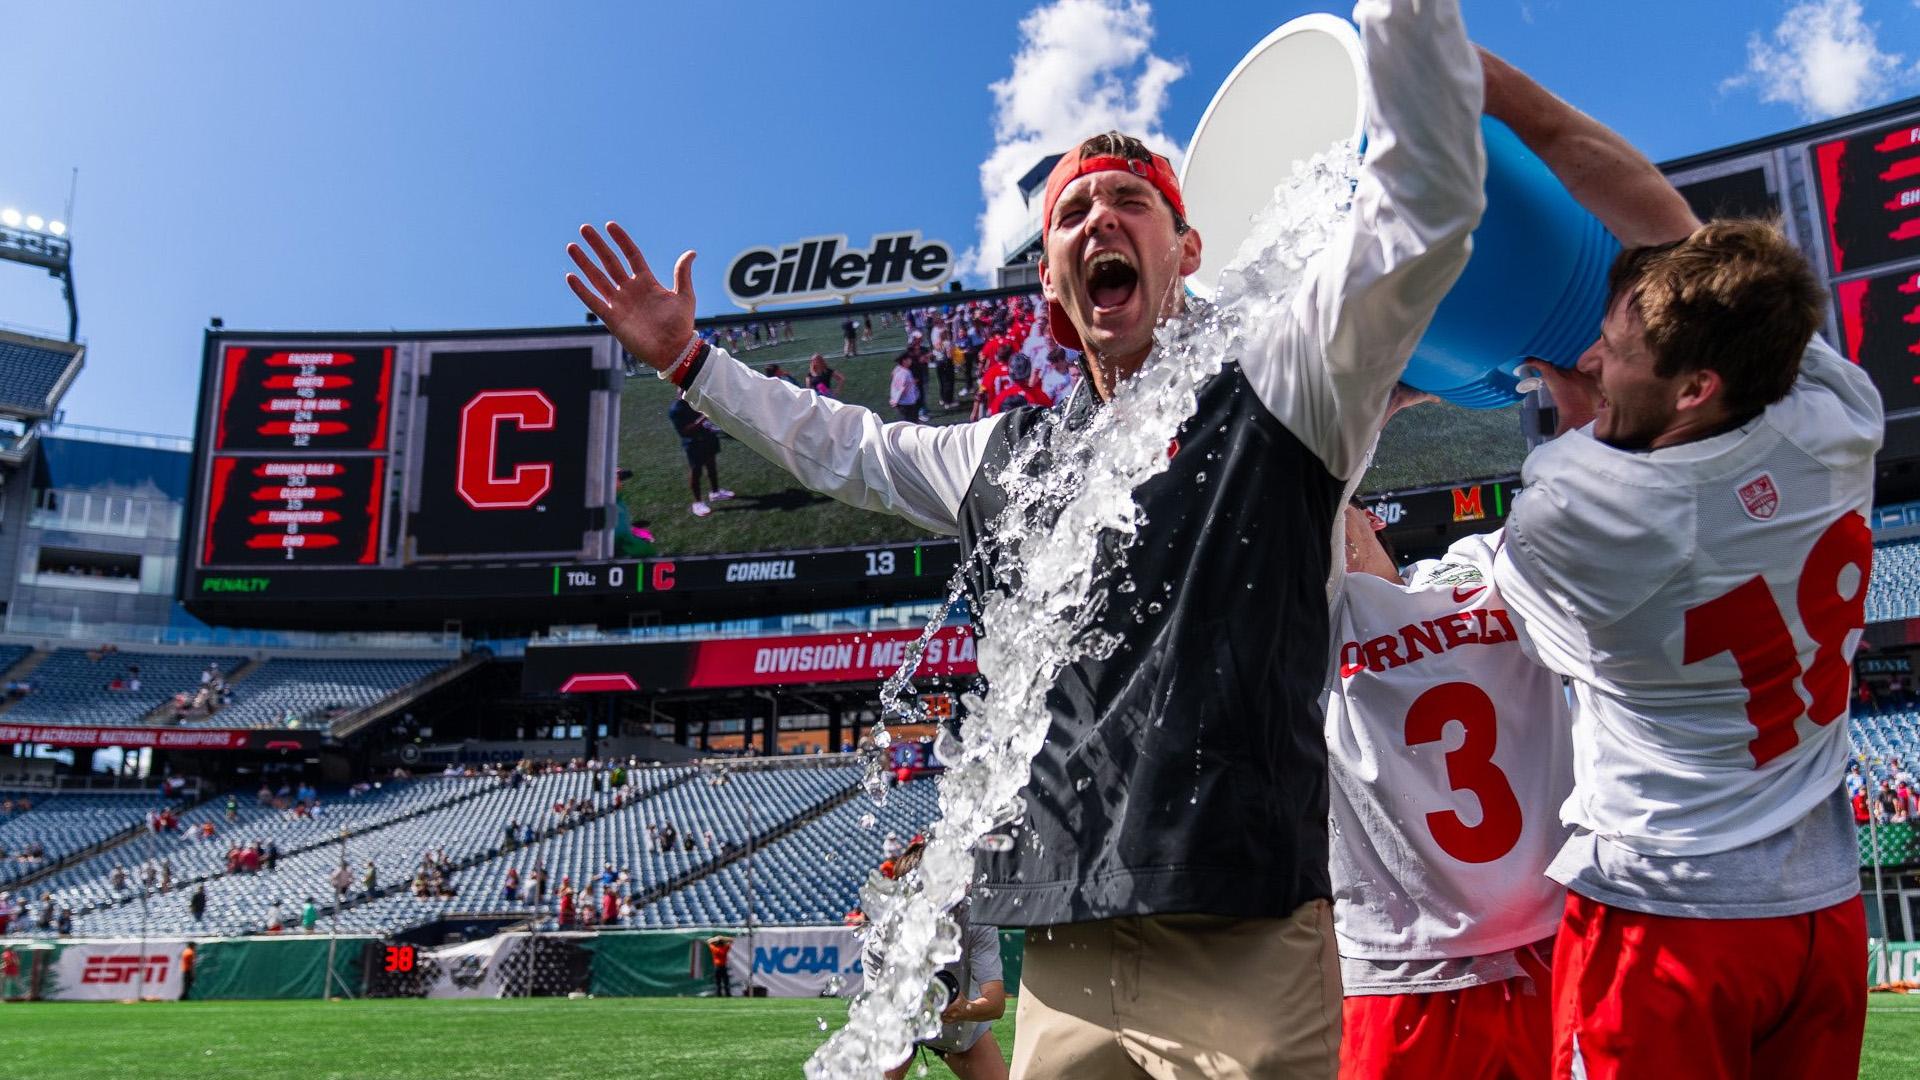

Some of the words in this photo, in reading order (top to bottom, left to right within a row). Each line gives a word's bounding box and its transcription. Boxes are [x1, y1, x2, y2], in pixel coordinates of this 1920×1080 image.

[729, 236, 948, 298] Gillette
[293, 376, 325, 387] SHOTS
[271, 398, 302, 410] SHOTS
[303, 398, 317, 410] ON
[318, 398, 341, 410] GOAL
[289, 422, 320, 434] SAVES
[457, 388, 556, 509] C
[265, 463, 305, 475] GROUND
[306, 463, 335, 475] BALLS
[280, 487, 316, 499] CLEARS
[1452, 485, 1485, 520] M
[268, 510, 324, 522] TURNOVERS
[566, 571, 596, 587] TOL:
[608, 566, 623, 587] 0
[652, 561, 675, 590] C
[725, 559, 796, 582] CORNELL
[865, 551, 896, 576] 13
[203, 578, 270, 592] PENALTY
[1682, 509, 1874, 769] 18
[754, 643, 853, 673] DIVISION
[870, 638, 942, 668] MES
[32, 728, 98, 743] LACROSSE
[100, 729, 157, 744] NATIONAL
[160, 731, 231, 746] CHAMPIONS
[1404, 682, 1523, 864] 3
[81, 956, 170, 984] ESPN
[385, 946, 413, 972] 38
